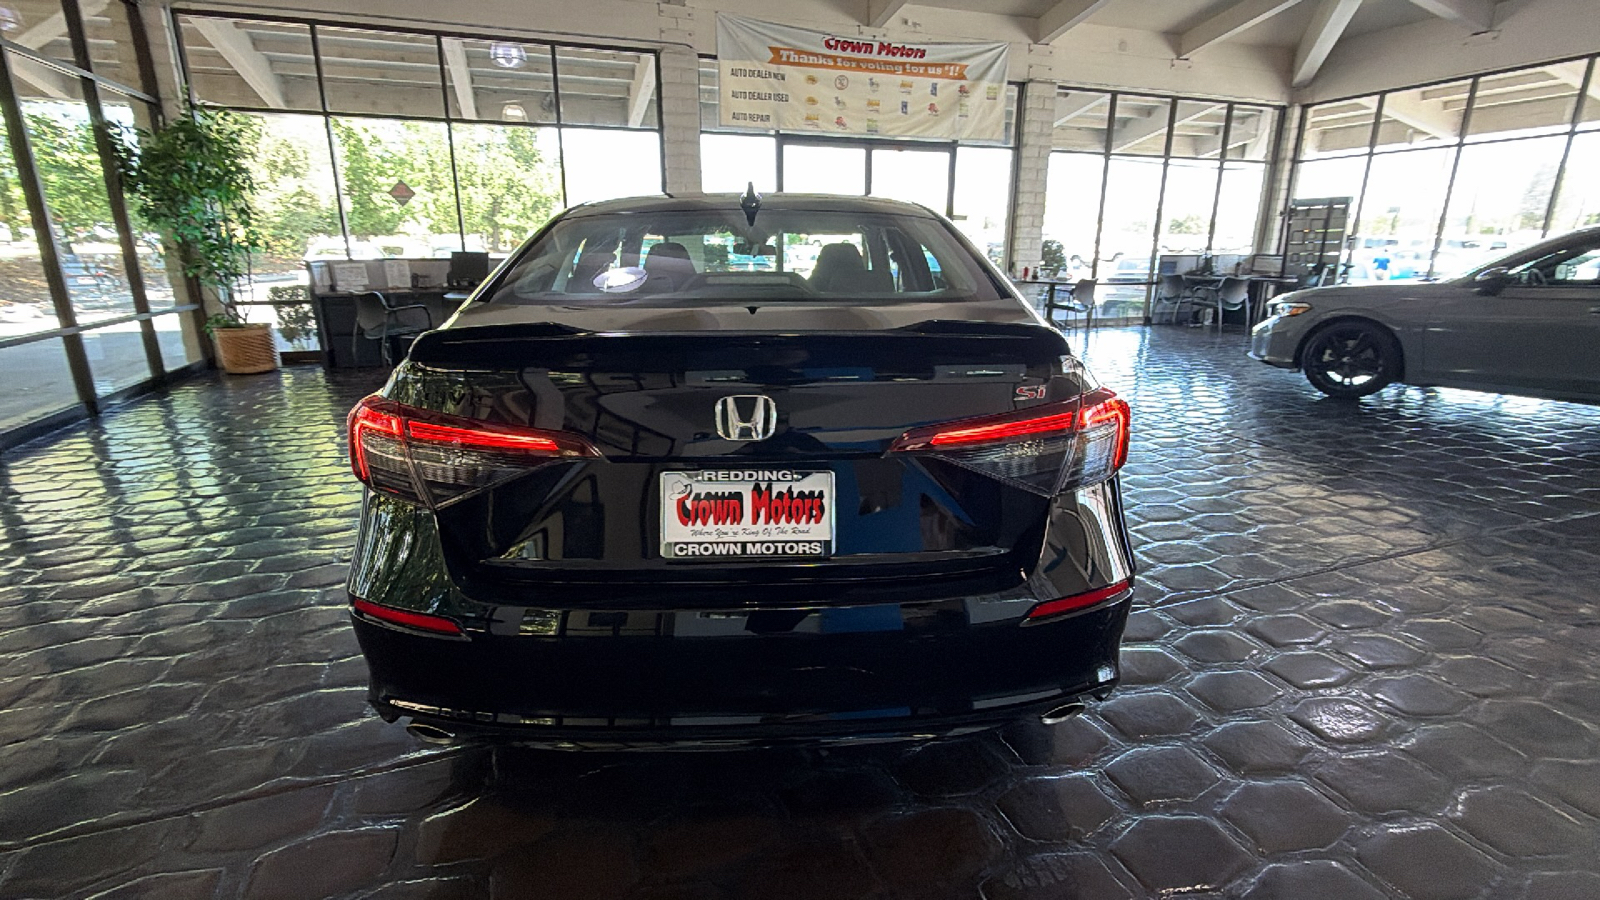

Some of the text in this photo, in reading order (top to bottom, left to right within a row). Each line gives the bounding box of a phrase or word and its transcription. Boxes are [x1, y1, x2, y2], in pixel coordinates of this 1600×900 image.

[824, 37, 927, 59] Crown Motors
[779, 50, 834, 66] Thanks
[836, 57, 857, 67] for
[860, 60, 902, 74] voting
[905, 62, 925, 73] for
[928, 65, 942, 75] us
[730, 68, 786, 81] AUTO DEALER NEW
[731, 90, 789, 102] AUTO DEALER USED
[732, 112, 770, 123] AUTO REPAIR
[1013, 384, 1046, 401] Si
[703, 470, 793, 481] REDDING
[676, 483, 825, 527] Crown Motors
[690, 526, 811, 539] Where You're King Of The Road
[674, 542, 822, 556] CROWN MOTORS
